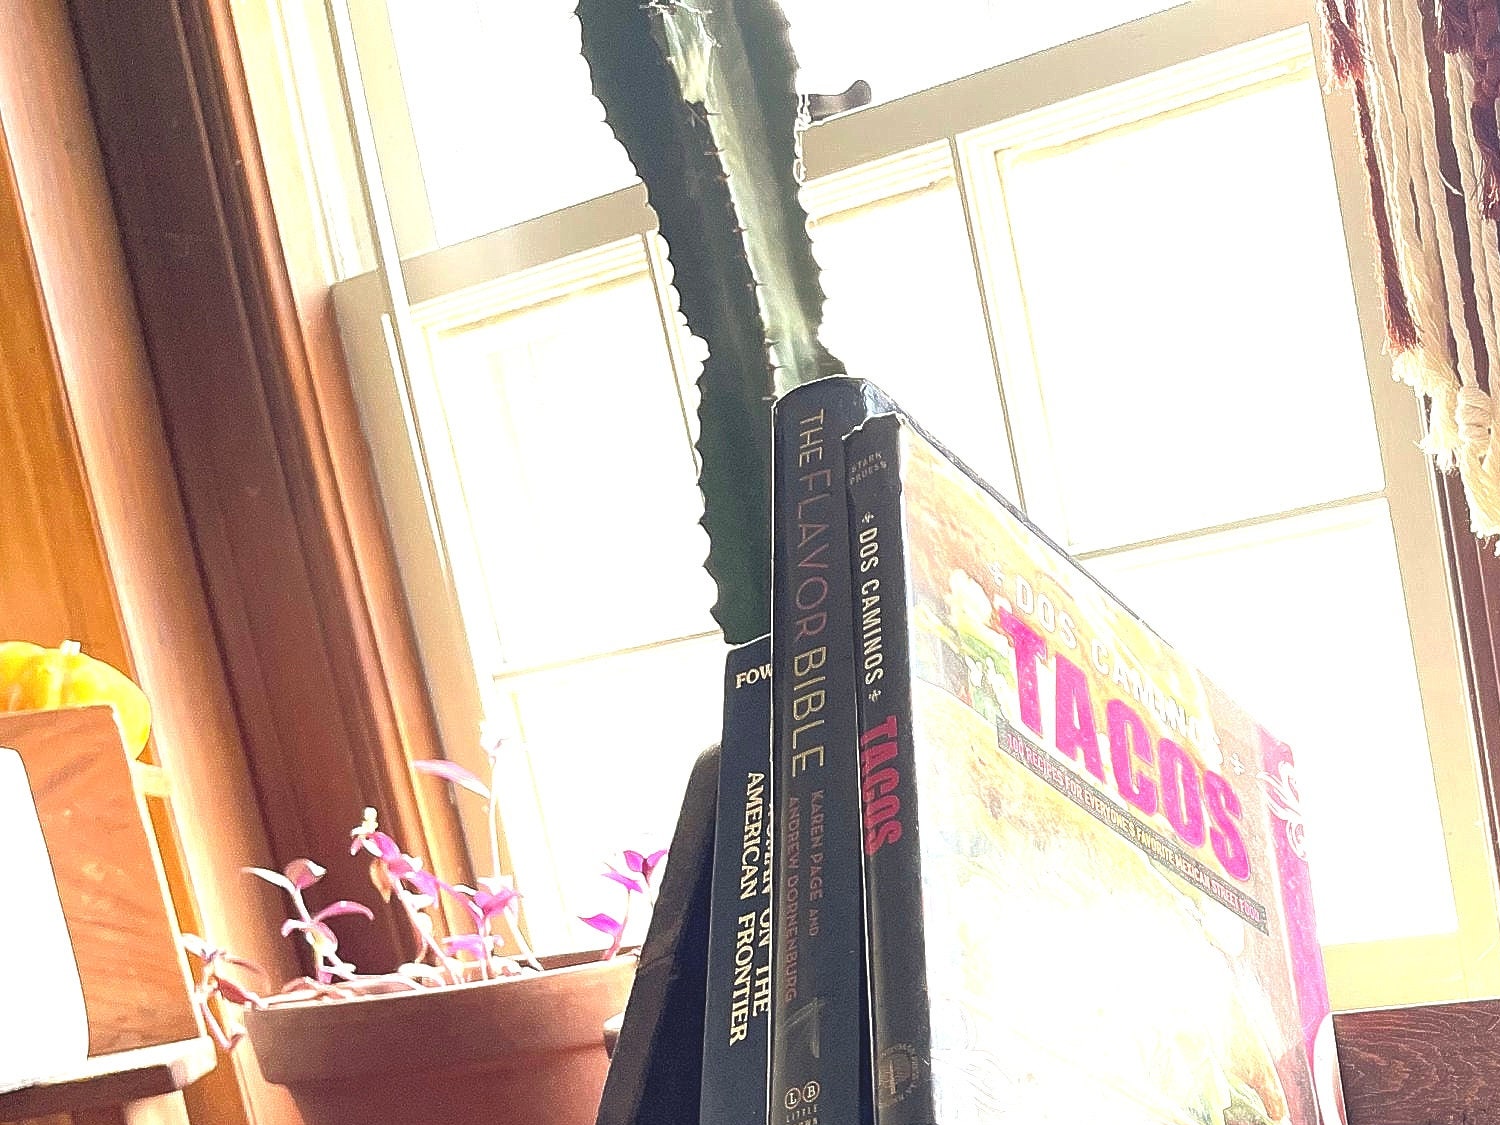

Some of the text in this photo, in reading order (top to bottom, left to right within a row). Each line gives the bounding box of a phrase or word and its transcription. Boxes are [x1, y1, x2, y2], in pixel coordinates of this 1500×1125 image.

[791, 408, 832, 778] THE FLAVOR BIBLE
[859, 527, 884, 686] DOS CAMINOS
[1016, 575, 1077, 650] DOS
[860, 714, 903, 857] TACOS
[999, 606, 1251, 881] TACOS
[809, 852, 824, 901] PAGE
[1026, 745, 1065, 790] RECIPES
[1064, 776, 1085, 804] FOR
[1135, 825, 1177, 866] FAVORITE
[1175, 855, 1212, 890] MEXICAN
[1211, 879, 1241, 913] STREET
[729, 772, 765, 1047] AMERICAN FRONTIER
[808, 909, 820, 937] AND
[786, 1104, 818, 1123] LITTLE
